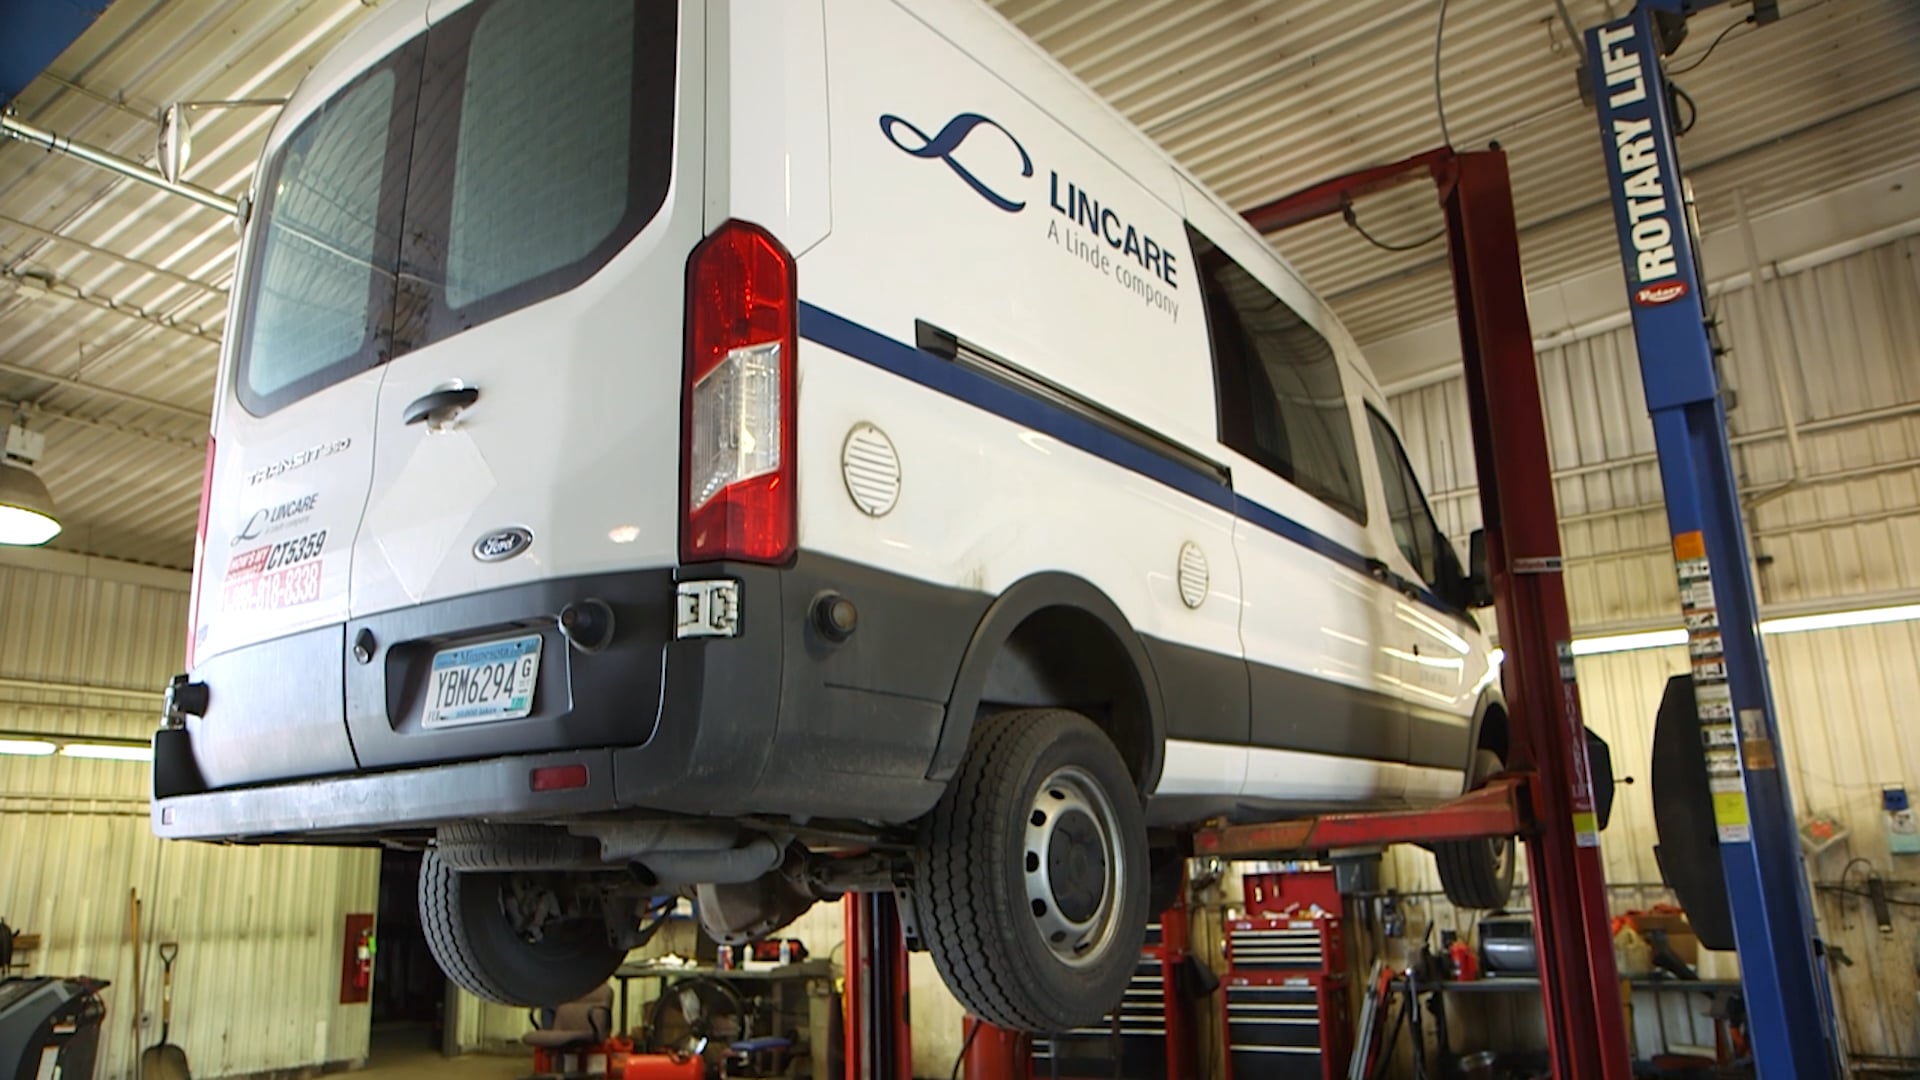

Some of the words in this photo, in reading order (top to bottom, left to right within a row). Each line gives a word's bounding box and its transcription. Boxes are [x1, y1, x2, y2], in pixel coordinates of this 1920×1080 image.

[1597, 23, 1648, 110] LIFT
[1613, 117, 1678, 283] ROTARY
[1050, 169, 1179, 289] LINCARE
[1047, 219, 1060, 246] A
[1066, 227, 1110, 276] Linde
[1115, 262, 1179, 324] company
[248, 446, 322, 486] TRANSIT
[270, 492, 319, 523] LINCARE
[267, 529, 327, 571] CT5359
[483, 533, 515, 555] Ford
[435, 660, 518, 709] YBM6294
[521, 657, 532, 678] G
